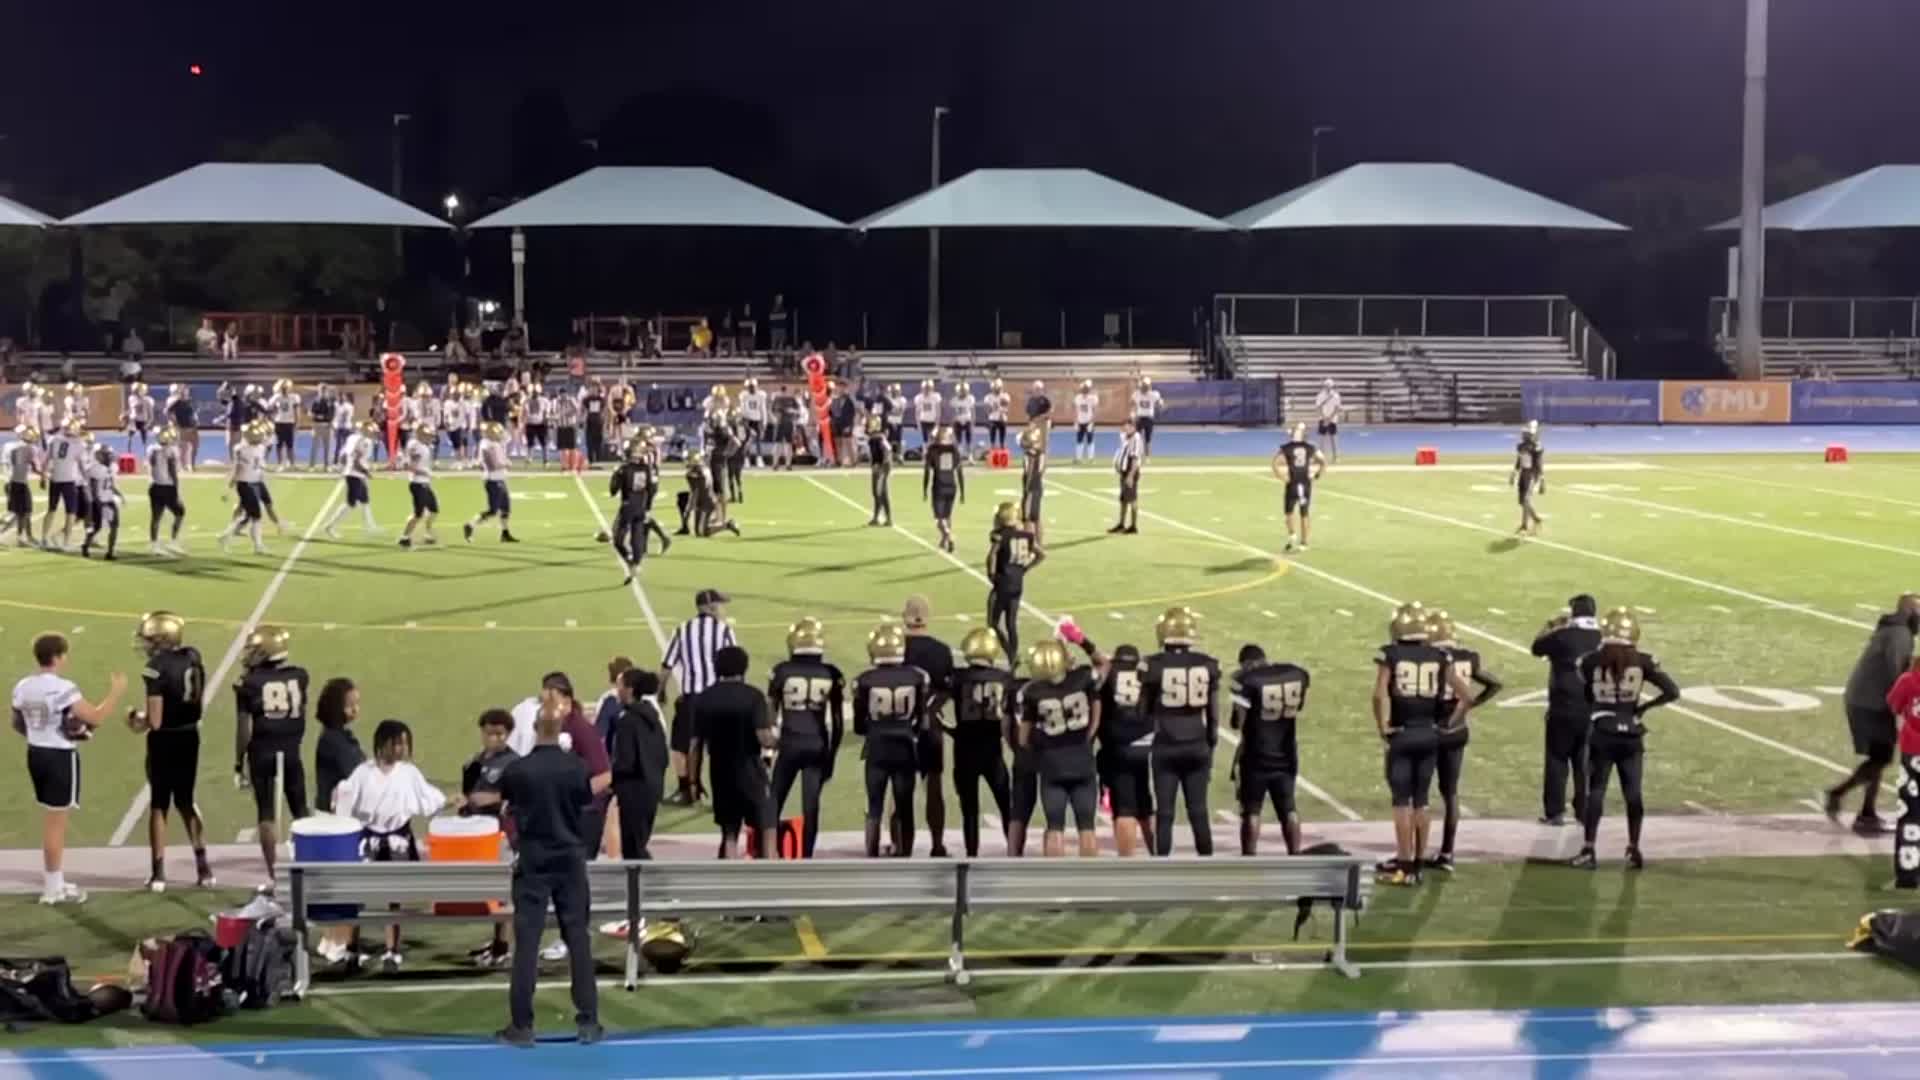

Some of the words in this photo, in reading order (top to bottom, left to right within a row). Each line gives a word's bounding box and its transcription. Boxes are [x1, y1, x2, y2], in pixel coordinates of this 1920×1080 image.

[1701, 386, 1769, 412] FMU
[1394, 660, 1440, 697] 20
[261, 679, 302, 720] 81
[1036, 690, 1090, 736] 33
